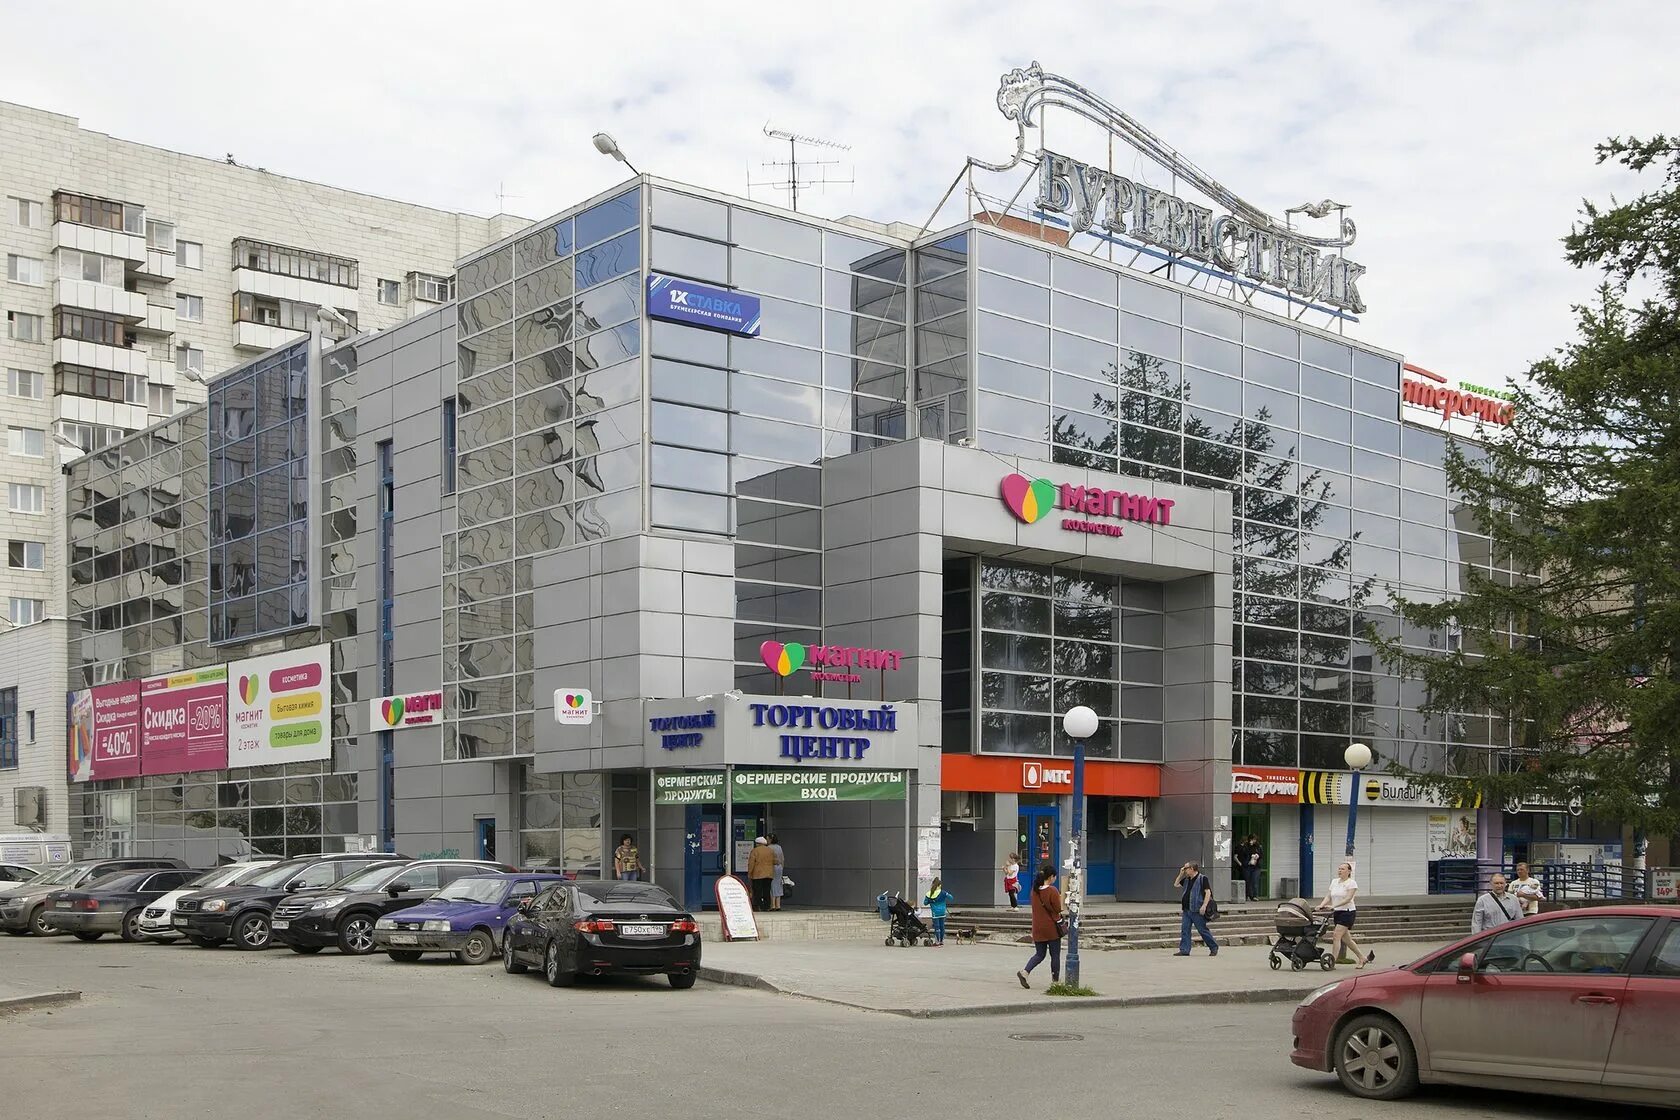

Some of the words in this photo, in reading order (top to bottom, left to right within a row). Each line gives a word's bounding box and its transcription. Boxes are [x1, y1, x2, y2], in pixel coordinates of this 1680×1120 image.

[1034, 148, 1368, 314] БУРЕВЕСТНИК
[670, 304, 712, 317] БУКМЕКЕРСКАЯ
[713, 313, 742, 323] КОМПАНИЯ
[282, 672, 308, 684] косметика
[96, 697, 119, 708] Выгодные
[119, 694, 137, 704] недели
[277, 703, 298, 713] бытовая
[298, 700, 314, 709] химия
[96, 711, 116, 724] Скидка
[144, 706, 186, 730] Скидка
[649, 710, 716, 732] ТОРГОВЫЙ
[750, 704, 898, 732] ТОРГОВЫЙ
[275, 731, 293, 741] товары
[293, 730, 303, 738] для
[304, 727, 317, 737] дома
[238, 738, 243, 751] 2
[243, 740, 260, 751] этаж
[661, 733, 704, 751] ЦЕНТР
[779, 735, 871, 763] ЦЕНТР
[657, 774, 724, 788] ФЕРМЕРСКИЕ
[735, 773, 827, 785] ФЕРМЕРСКИЕ
[830, 772, 902, 786] ПРОДУКТЫ
[1043, 769, 1071, 784] МТС
[664, 788, 716, 803] ПРОДУКТЫ
[801, 788, 838, 801] ВХОД
